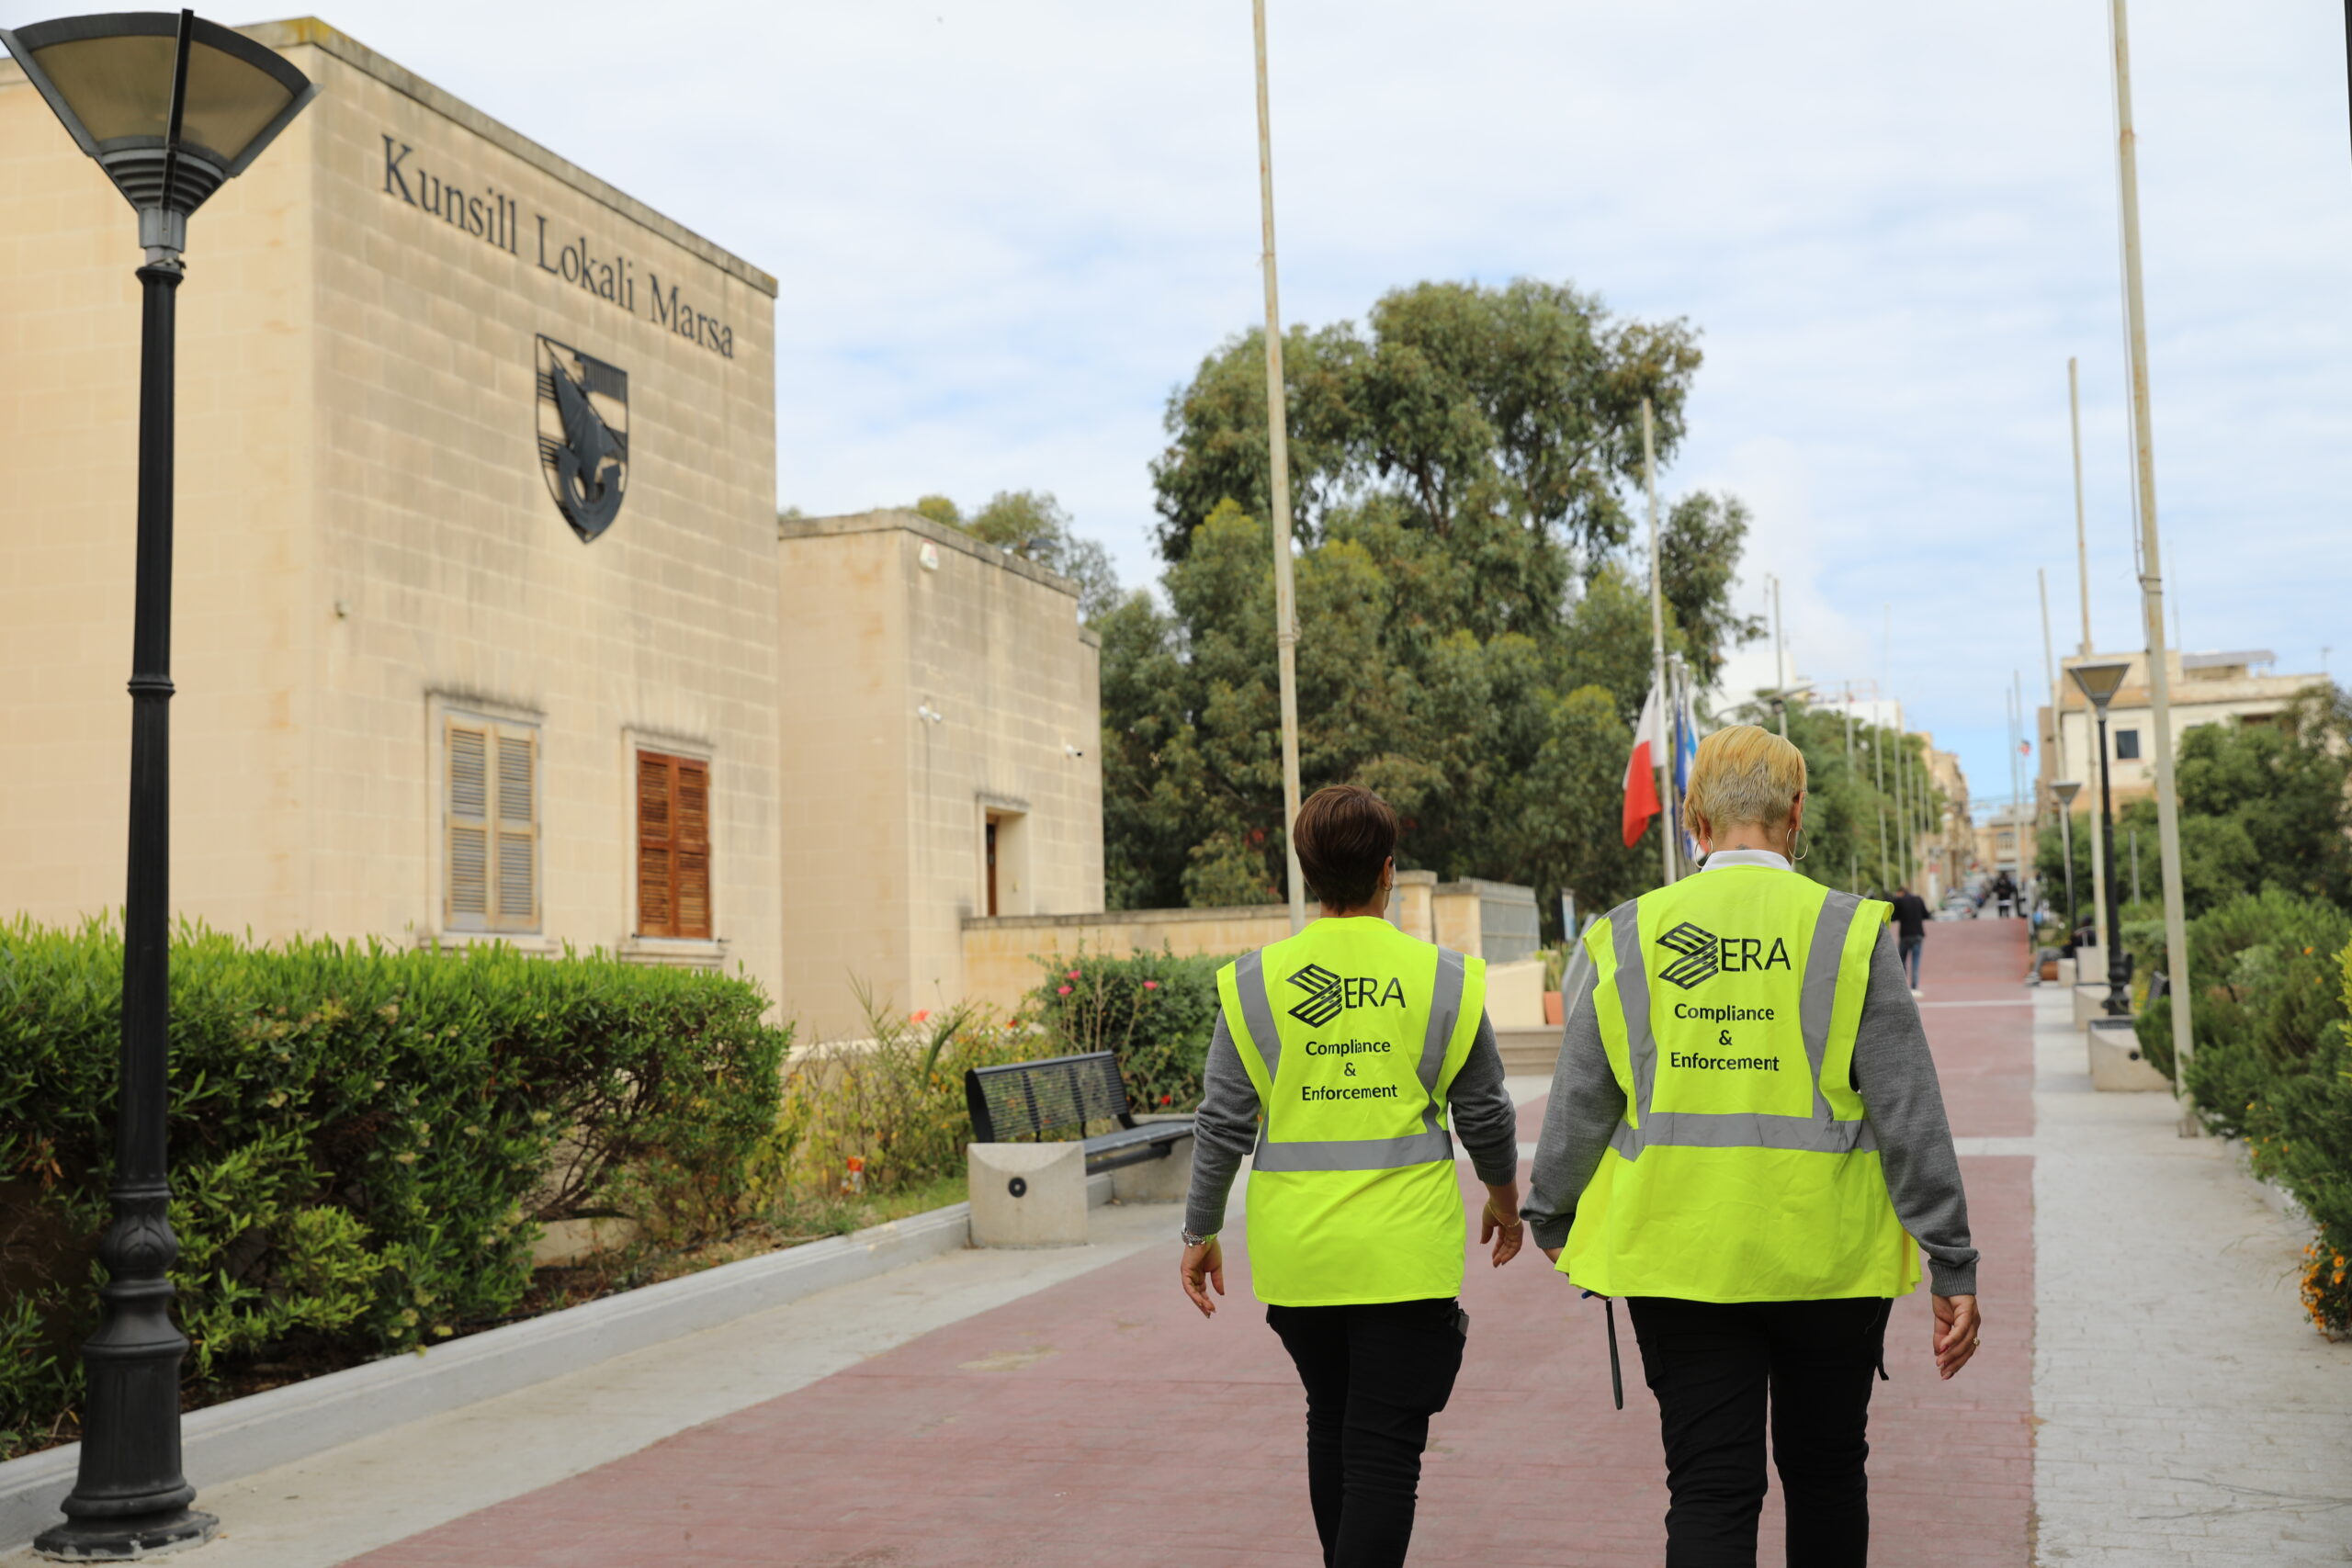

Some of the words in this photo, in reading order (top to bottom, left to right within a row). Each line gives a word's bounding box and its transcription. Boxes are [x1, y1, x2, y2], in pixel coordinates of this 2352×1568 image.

[380, 132, 518, 256] Kunsill
[535, 213, 635, 311] Lokali
[649, 273, 734, 359] Marsa
[1721, 937, 1791, 972] ERA
[1344, 976, 1407, 1009] ERA
[1674, 1003, 1774, 1023] Compliance
[1718, 1030, 1733, 1045] &
[1305, 1039, 1391, 1056] Compliance
[1344, 1062, 1357, 1077] &
[1670, 1052, 1780, 1071] Enforcement
[1301, 1083, 1398, 1101] Enforcement
